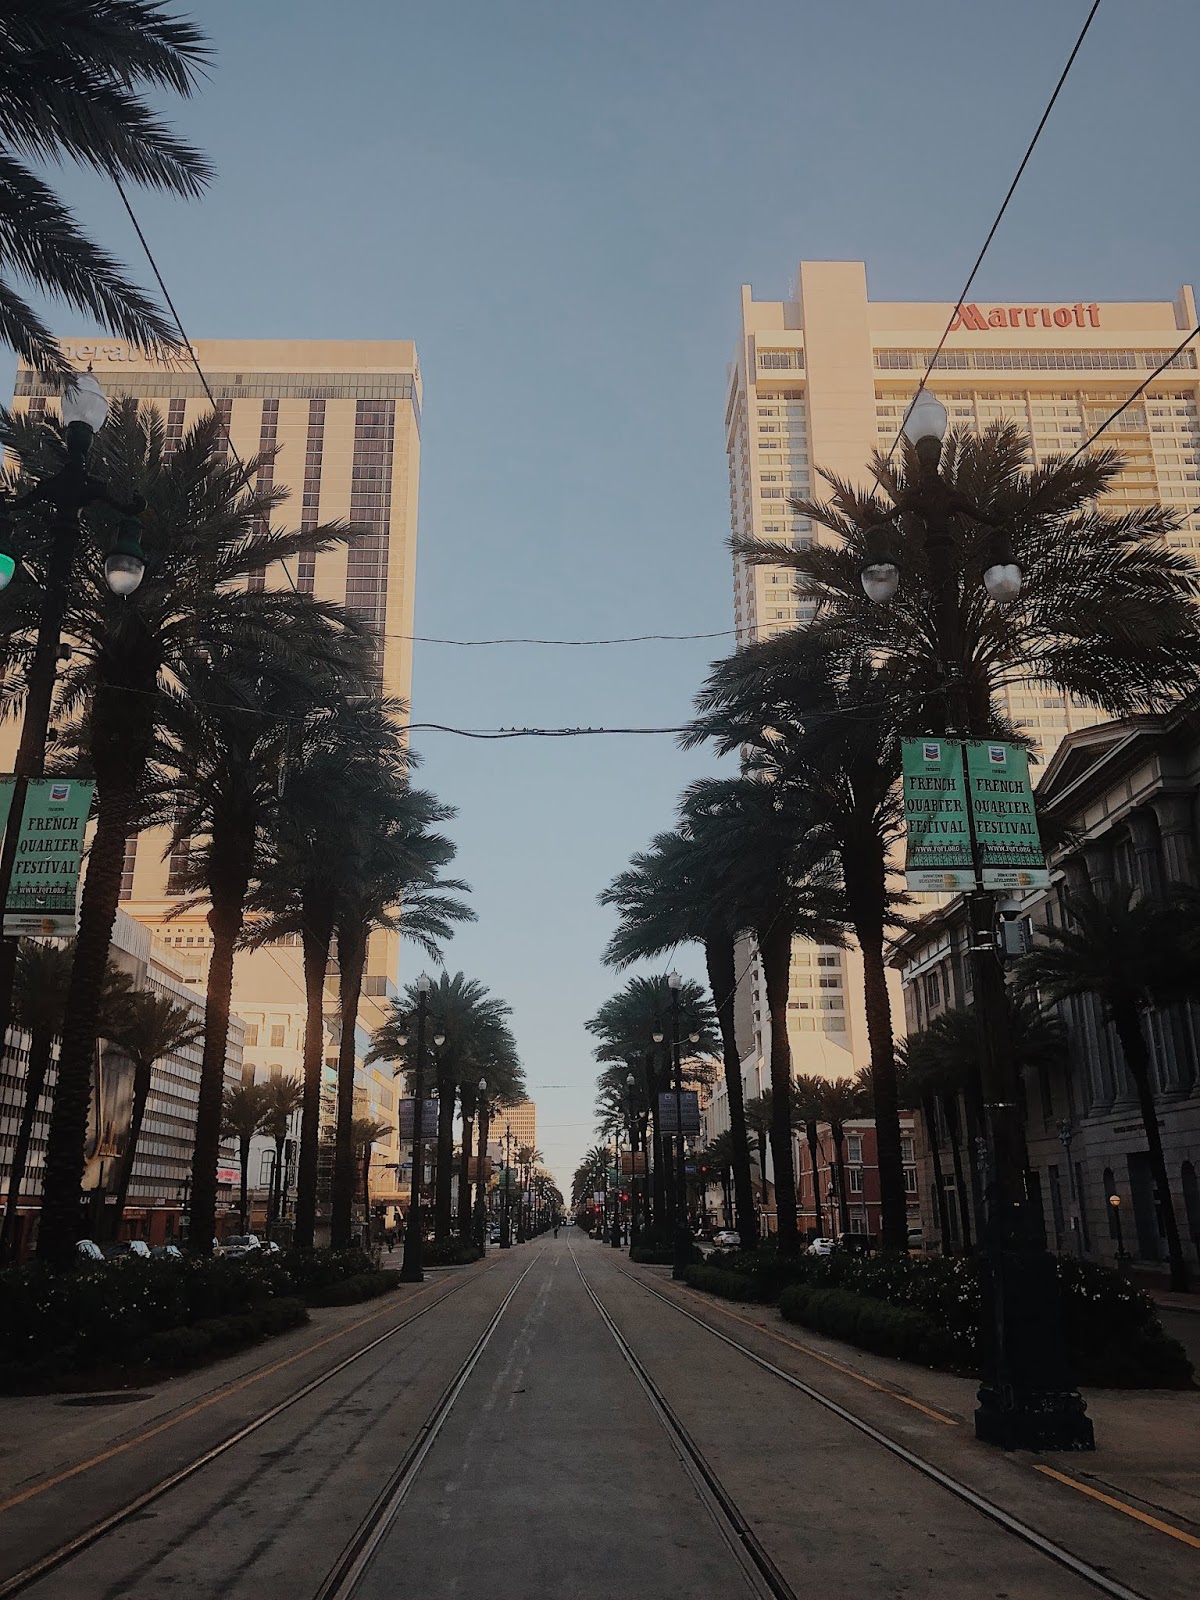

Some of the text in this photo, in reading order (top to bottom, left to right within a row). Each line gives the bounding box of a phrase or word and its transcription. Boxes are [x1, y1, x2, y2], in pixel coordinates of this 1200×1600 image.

[949, 302, 1101, 331] Marriott
[910, 777, 957, 791] FRENCH
[976, 778, 1025, 794] FRENCH
[907, 799, 964, 813] QUARTER
[974, 801, 1032, 815] QUARTER
[28, 817, 80, 831] FRENCH
[976, 820, 1036, 835] FESTIVAL
[20, 838, 79, 854] QUARTER
[15, 860, 77, 875] FESTIVAL
